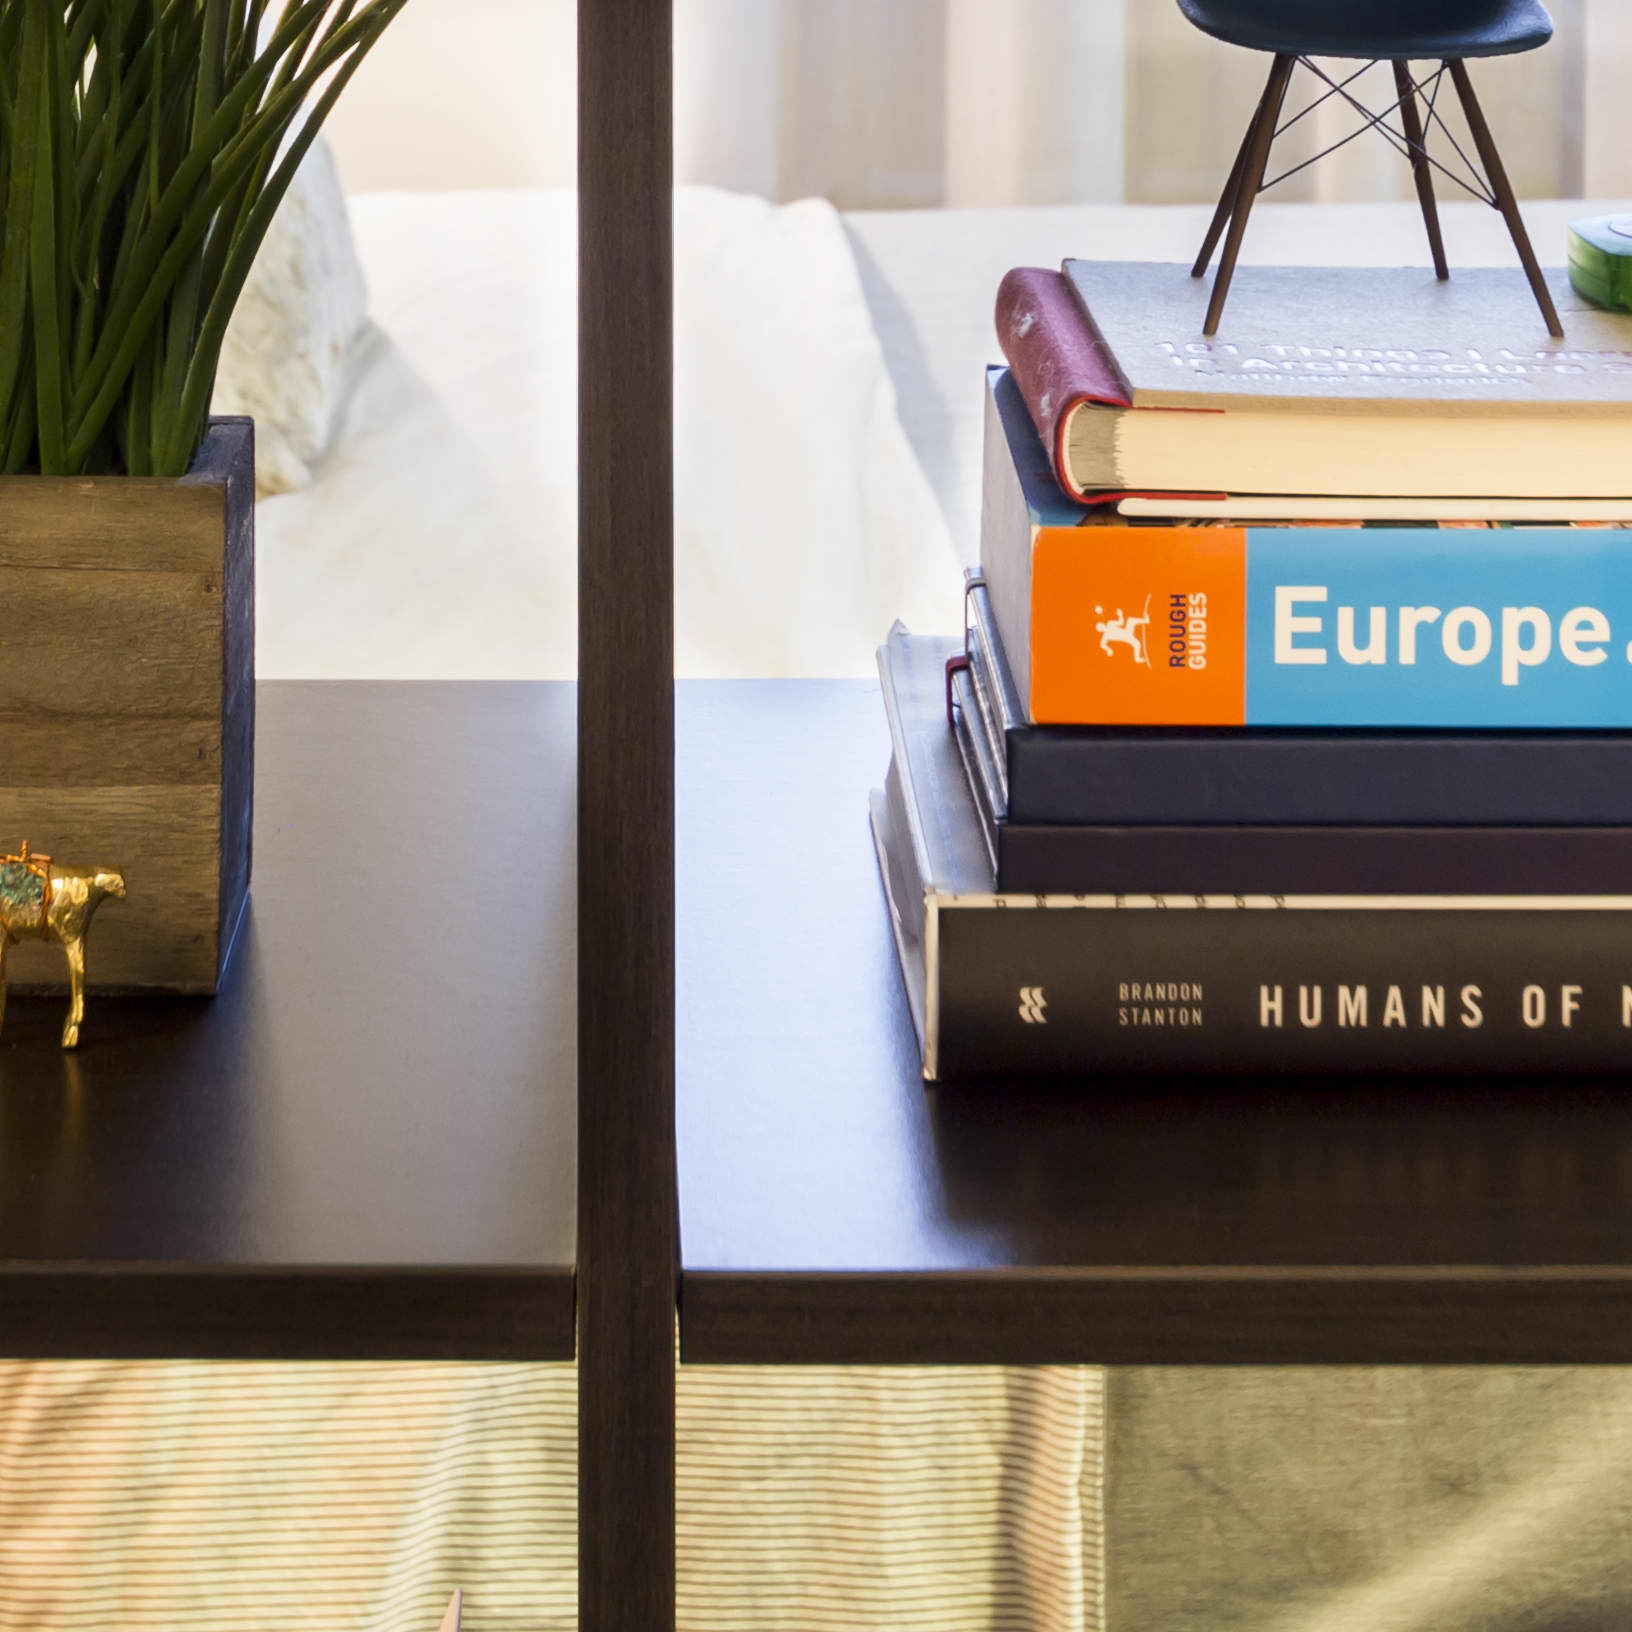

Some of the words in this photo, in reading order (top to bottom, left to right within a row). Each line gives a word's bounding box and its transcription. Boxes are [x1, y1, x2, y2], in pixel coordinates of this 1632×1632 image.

[1168, 593, 1188, 668] ROUGH
[1188, 591, 1208, 671] GUIDES
[1273, 585, 1611, 686] Europe
[1118, 982, 1204, 1002] BRANDON
[1118, 1006, 1204, 1027] STANTON
[1259, 983, 1485, 1028] HUMANS
[1521, 983, 1583, 1028] OF
